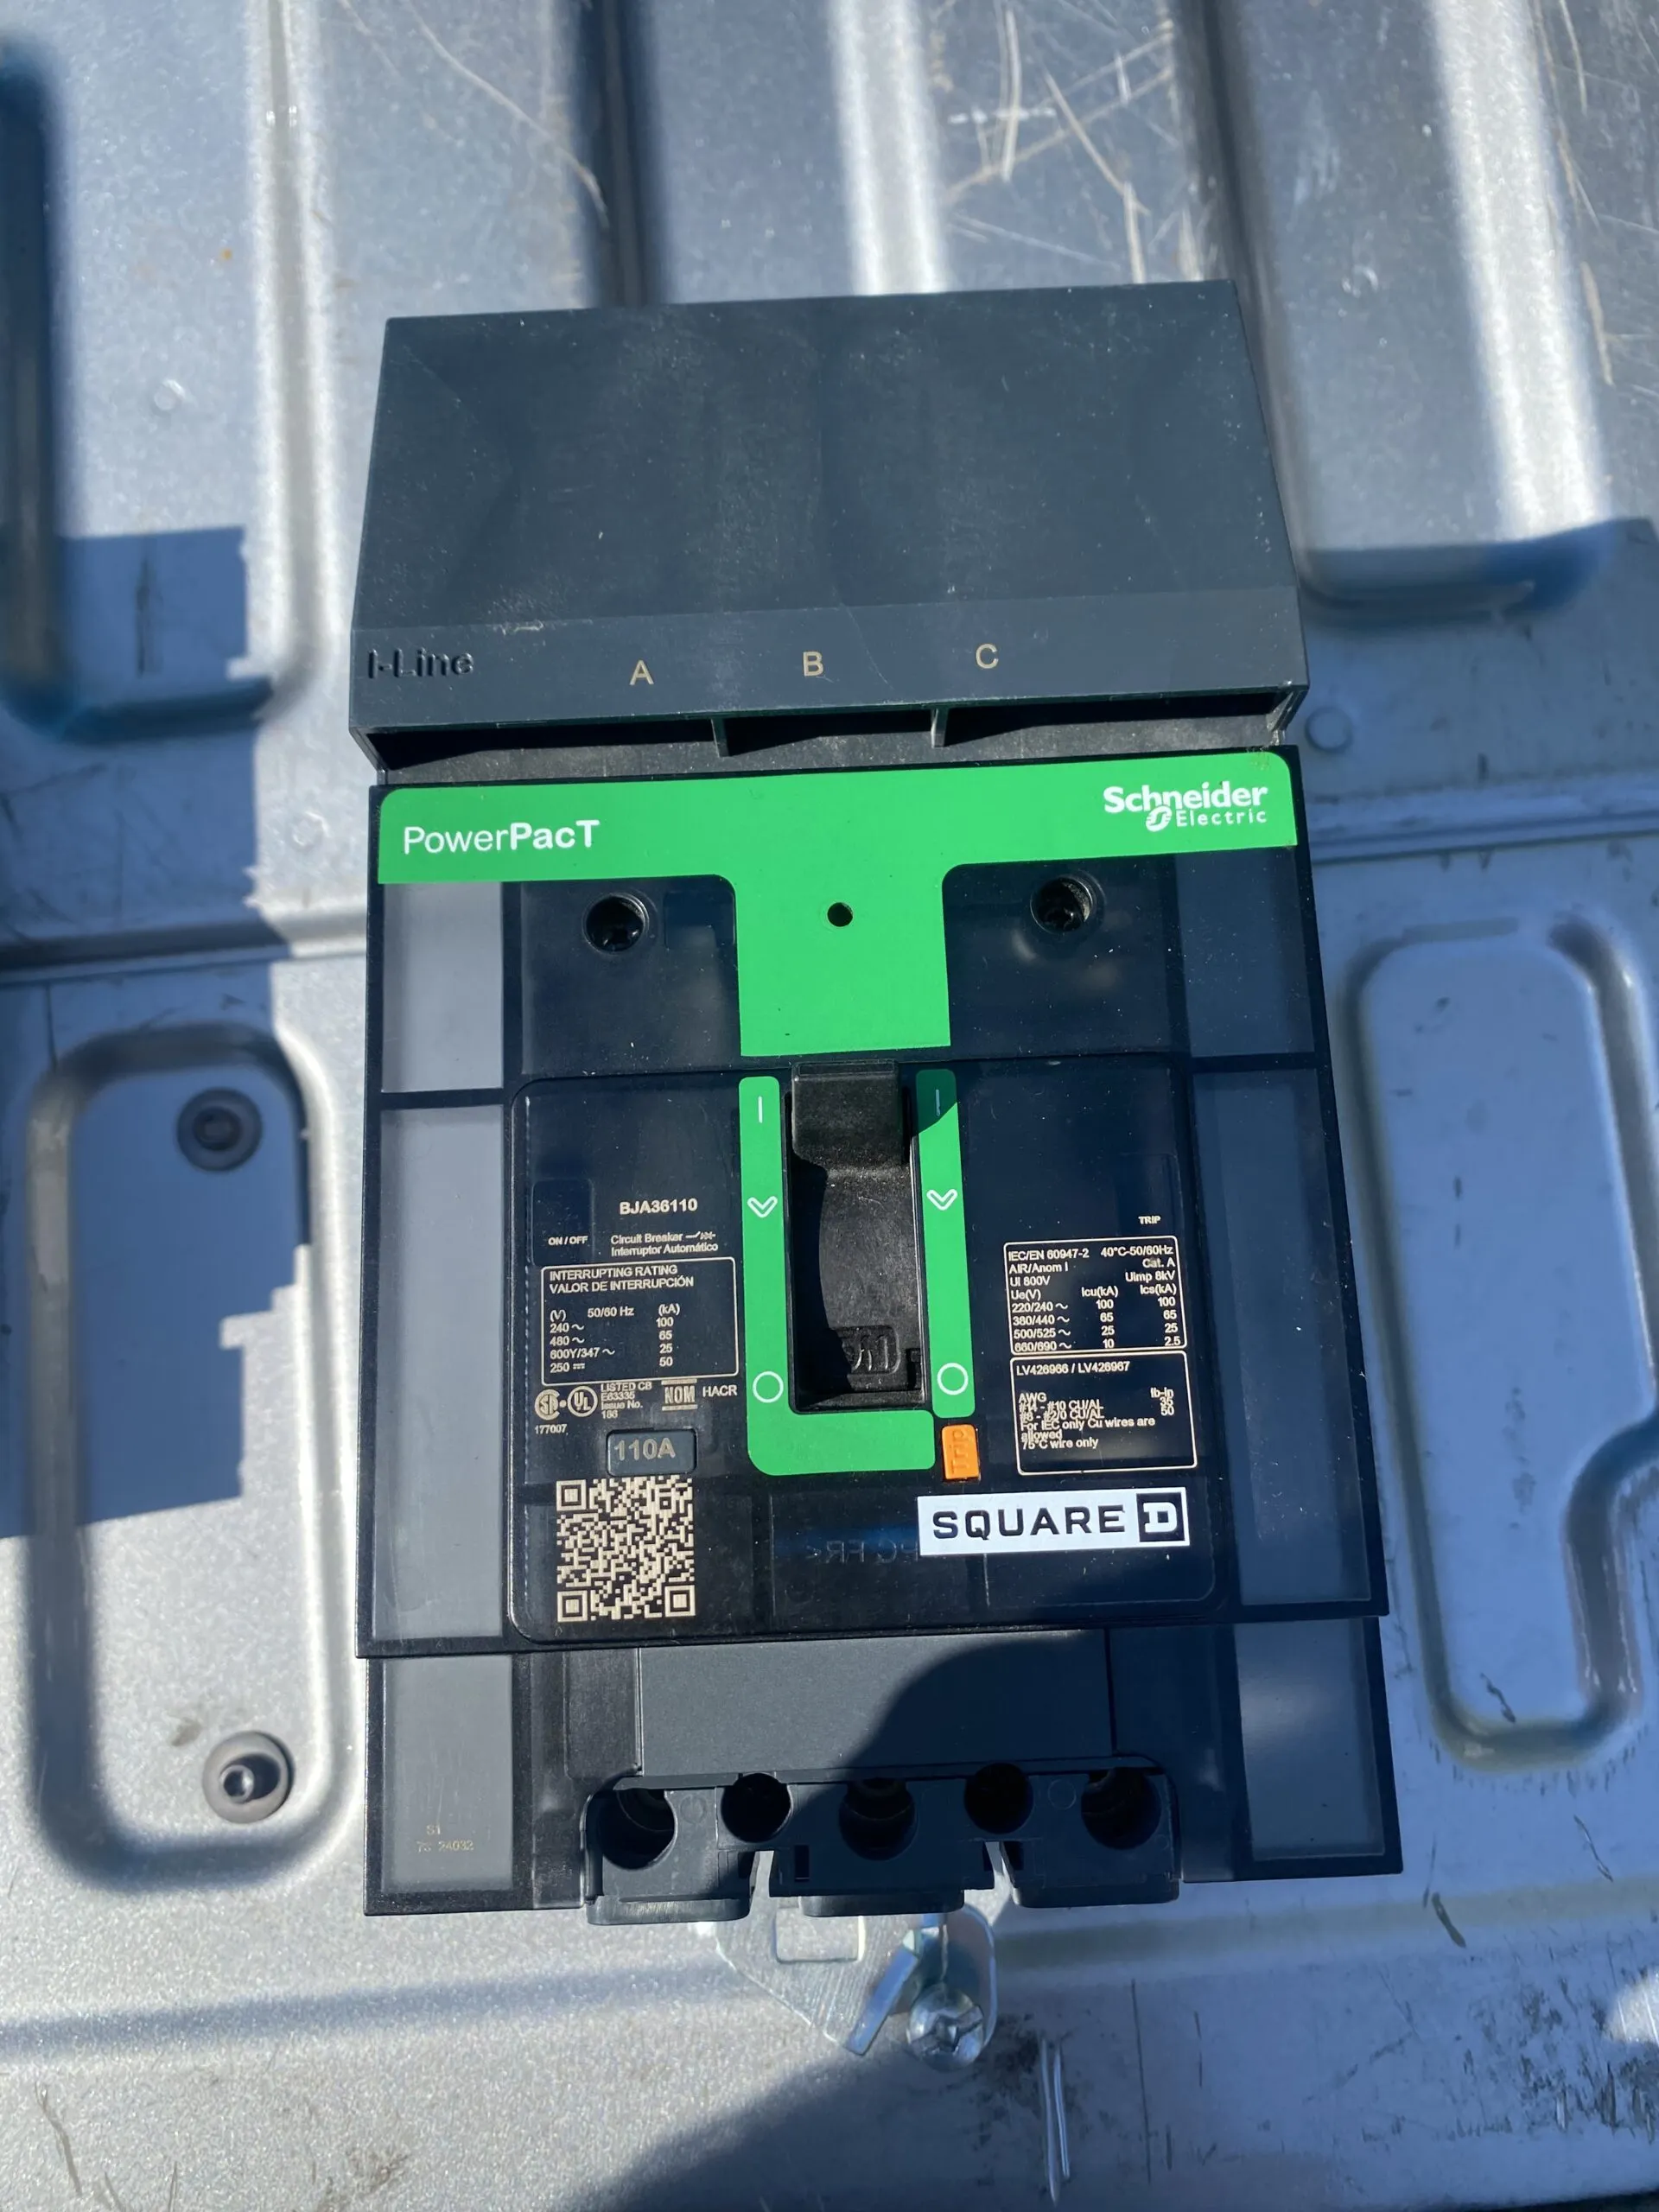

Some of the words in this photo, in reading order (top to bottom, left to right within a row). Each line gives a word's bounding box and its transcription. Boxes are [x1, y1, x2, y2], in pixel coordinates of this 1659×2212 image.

[367, 648, 474, 680] I-Line
[803, 651, 825, 677] B
[976, 644, 999, 669] C
[630, 660, 654, 685] A
[1103, 780, 1268, 813] Schneider
[1176, 809, 1267, 827] Electric
[403, 820, 600, 855] PowerPacT
[620, 1198, 698, 1215] BJA36110
[1138, 1216, 1161, 1224] TRIP
[611, 1233, 642, 1244] Circuit
[645, 1232, 683, 1243] Breaker
[611, 1244, 662, 1257] Interruptor
[664, 1243, 718, 1255] Automático
[1008, 1249, 1044, 1262] IEC/EN
[1047, 1248, 1090, 1260] 60947-2
[1142, 1258, 1165, 1268] Cat.
[1166, 1257, 1176, 1268] A
[550, 1267, 632, 1281] INTERRUPTING
[634, 1264, 678, 1276] RATING
[1023, 1275, 1051, 1287] 800V
[1155, 1269, 1176, 1281] 8kV
[550, 1282, 588, 1294] VALOR
[592, 1281, 607, 1292] DE
[610, 1275, 694, 1291] INTERRUPCIÓN
[1011, 1289, 1041, 1301] Ue(V)
[1081, 1286, 1119, 1298] Icu(kA)
[1140, 1283, 1177, 1296] Ics(kA)
[550, 1309, 566, 1322] (V)
[588, 1306, 617, 1318] 50/60
[620, 1306, 634, 1317] Hz
[658, 1303, 681, 1316] (kA)
[1012, 1301, 1053, 1313] 220/240
[1096, 1299, 1114, 1310] 100
[1158, 1296, 1176, 1307] 100
[550, 1323, 569, 1333] 240
[656, 1317, 674, 1327] 100
[1013, 1314, 1055, 1326] 380/440
[1100, 1313, 1114, 1323] 65
[1163, 1309, 1177, 1320] 65
[550, 1336, 569, 1346] 480
[658, 1331, 673, 1341] 65
[1014, 1328, 1056, 1339] 500/525
[1102, 1325, 1115, 1336] 25
[1165, 1323, 1178, 1333] 25
[550, 1347, 601, 1360] 600Y/347
[659, 1344, 673, 1354] 25
[1014, 1341, 1057, 1352] 660/690
[1103, 1338, 1115, 1349] 10
[1165, 1336, 1181, 1346] 2.5
[550, 1363, 570, 1374] 250
[659, 1357, 674, 1368] 50
[601, 1382, 636, 1392] LISTED
[638, 1382, 652, 1391] CB
[664, 1385, 696, 1404] NOM
[702, 1385, 738, 1397] HACR
[627, 1400, 644, 1409] No.
[1018, 1392, 1047, 1403] AWG
[1069, 1399, 1104, 1410] CU/AL
[1070, 1408, 1105, 1420] CU/AL
[1160, 1405, 1175, 1416] 50
[1020, 1421, 1039, 1431] For
[1041, 1419, 1060, 1431] IEC
[1062, 1419, 1084, 1431] only
[1088, 1418, 1103, 1428] Cu
[1105, 1417, 1135, 1427] wires
[1137, 1417, 1155, 1427] are
[1021, 1429, 1063, 1441] allowed
[1050, 1439, 1073, 1449] wire
[1076, 1437, 1099, 1449] only
[614, 1437, 677, 1461] 110A
[932, 1504, 1126, 1540] SQUARE
[1143, 1502, 1178, 1533] D
